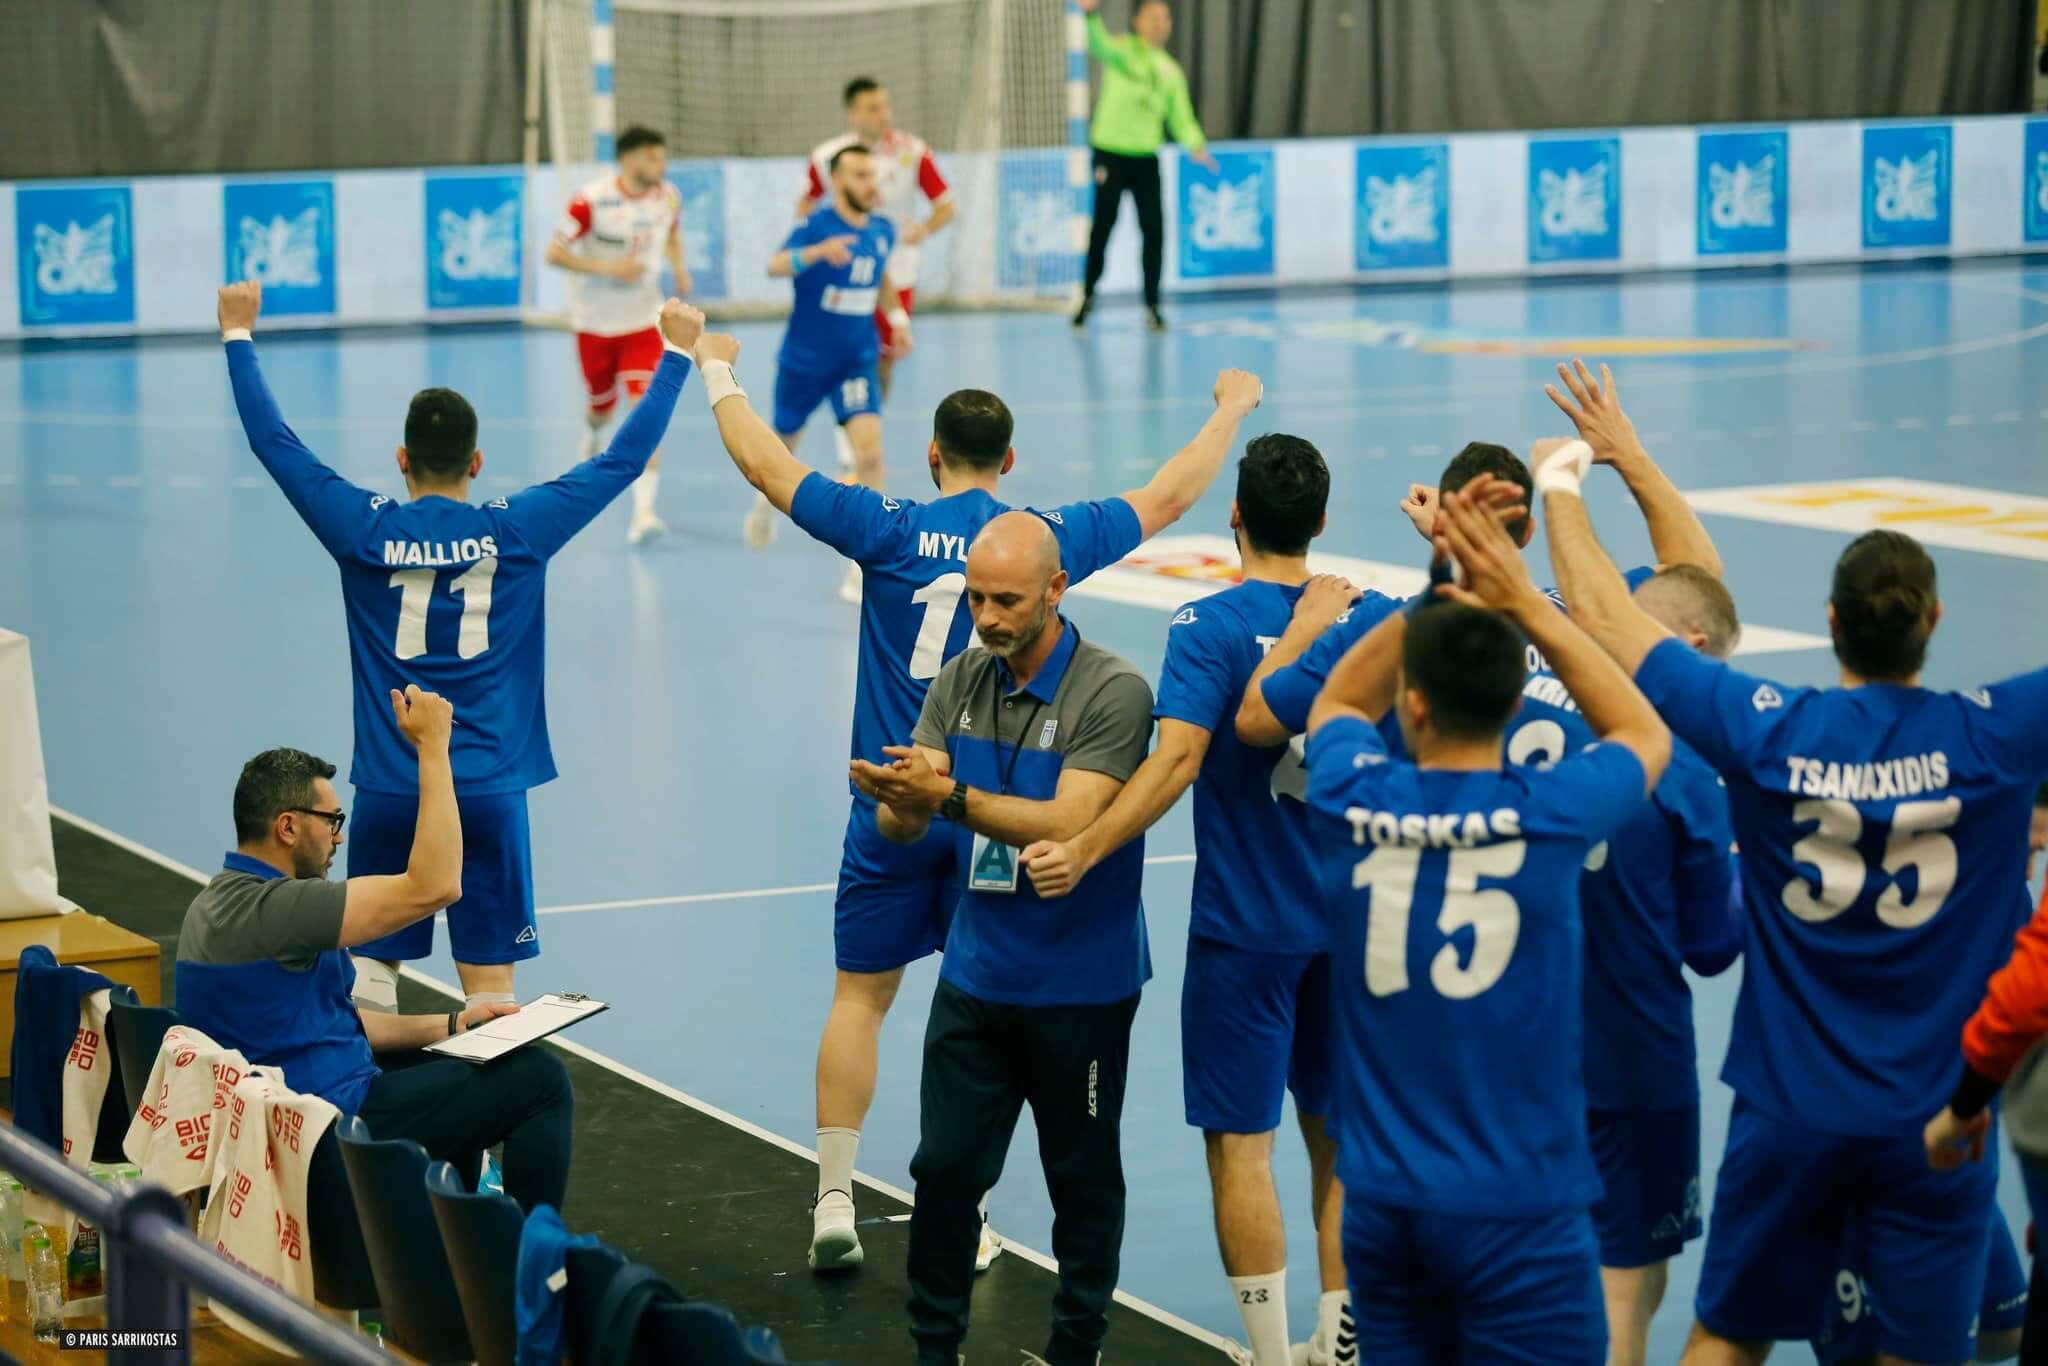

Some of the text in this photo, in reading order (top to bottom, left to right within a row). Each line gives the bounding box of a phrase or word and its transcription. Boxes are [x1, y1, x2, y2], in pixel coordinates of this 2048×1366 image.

[384, 535, 498, 565] MALLIOS
[918, 531, 973, 562] MYL
[389, 557, 498, 660] 11
[911, 572, 984, 680] 1
[1787, 752, 1949, 801] TSANAXIDIS
[1345, 807, 1521, 847] TOSKAS
[1782, 796, 1962, 929] 35
[1352, 839, 1527, 999] 15
[1240, 1288, 1269, 1304] 23
